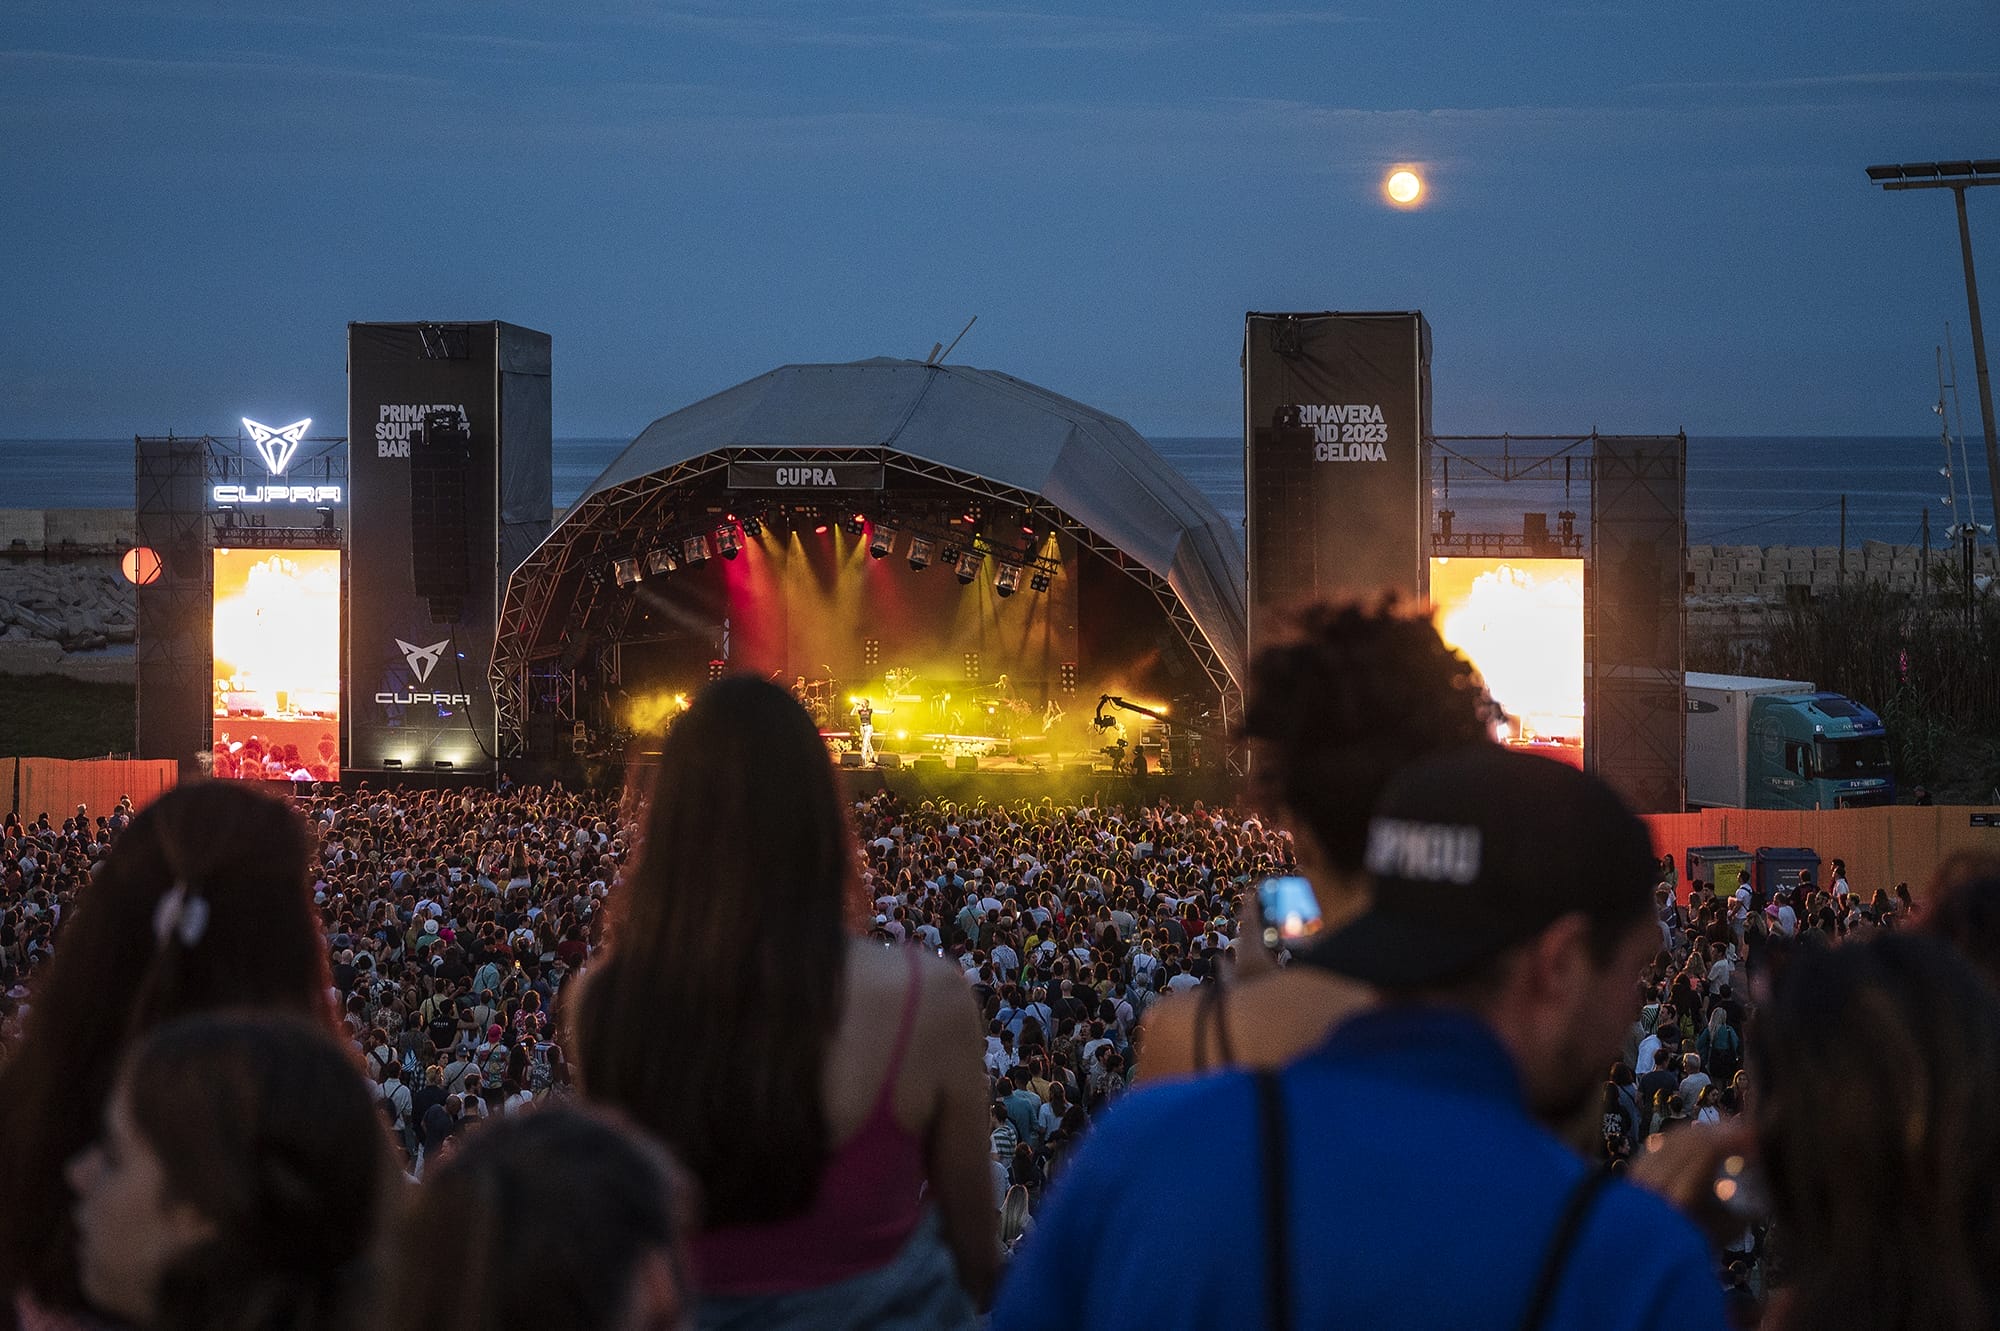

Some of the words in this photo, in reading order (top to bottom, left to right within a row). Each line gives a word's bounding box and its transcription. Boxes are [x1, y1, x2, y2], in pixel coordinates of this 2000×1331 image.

[1296, 404, 1385, 424] RIMAVERA
[1342, 424, 1388, 443] 2023
[1314, 443, 1388, 462] CELONA
[776, 467, 837, 486] CUPRA
[213, 485, 341, 503] CUPRA
[375, 692, 471, 706] CUPRA
[1686, 700, 1700, 711] TE
